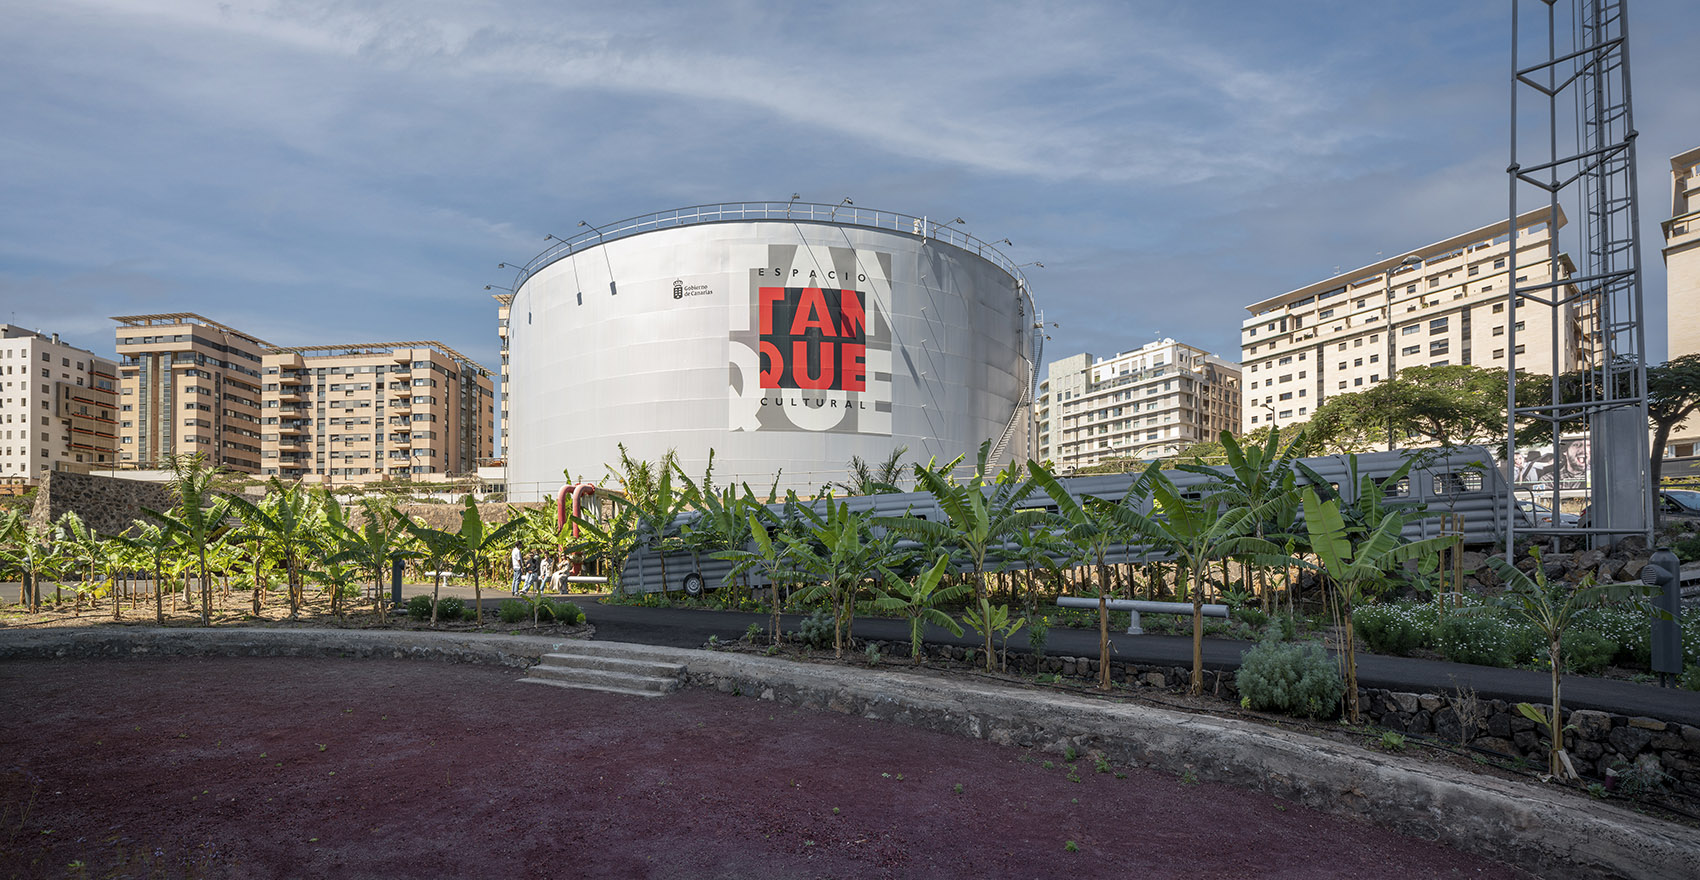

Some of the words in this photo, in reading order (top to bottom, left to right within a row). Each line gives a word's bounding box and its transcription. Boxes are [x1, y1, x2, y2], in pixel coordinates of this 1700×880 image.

[758, 267, 867, 283] ESPACIO
[690, 289, 713, 297] Canarias
[760, 397, 867, 410] CULTURAL
